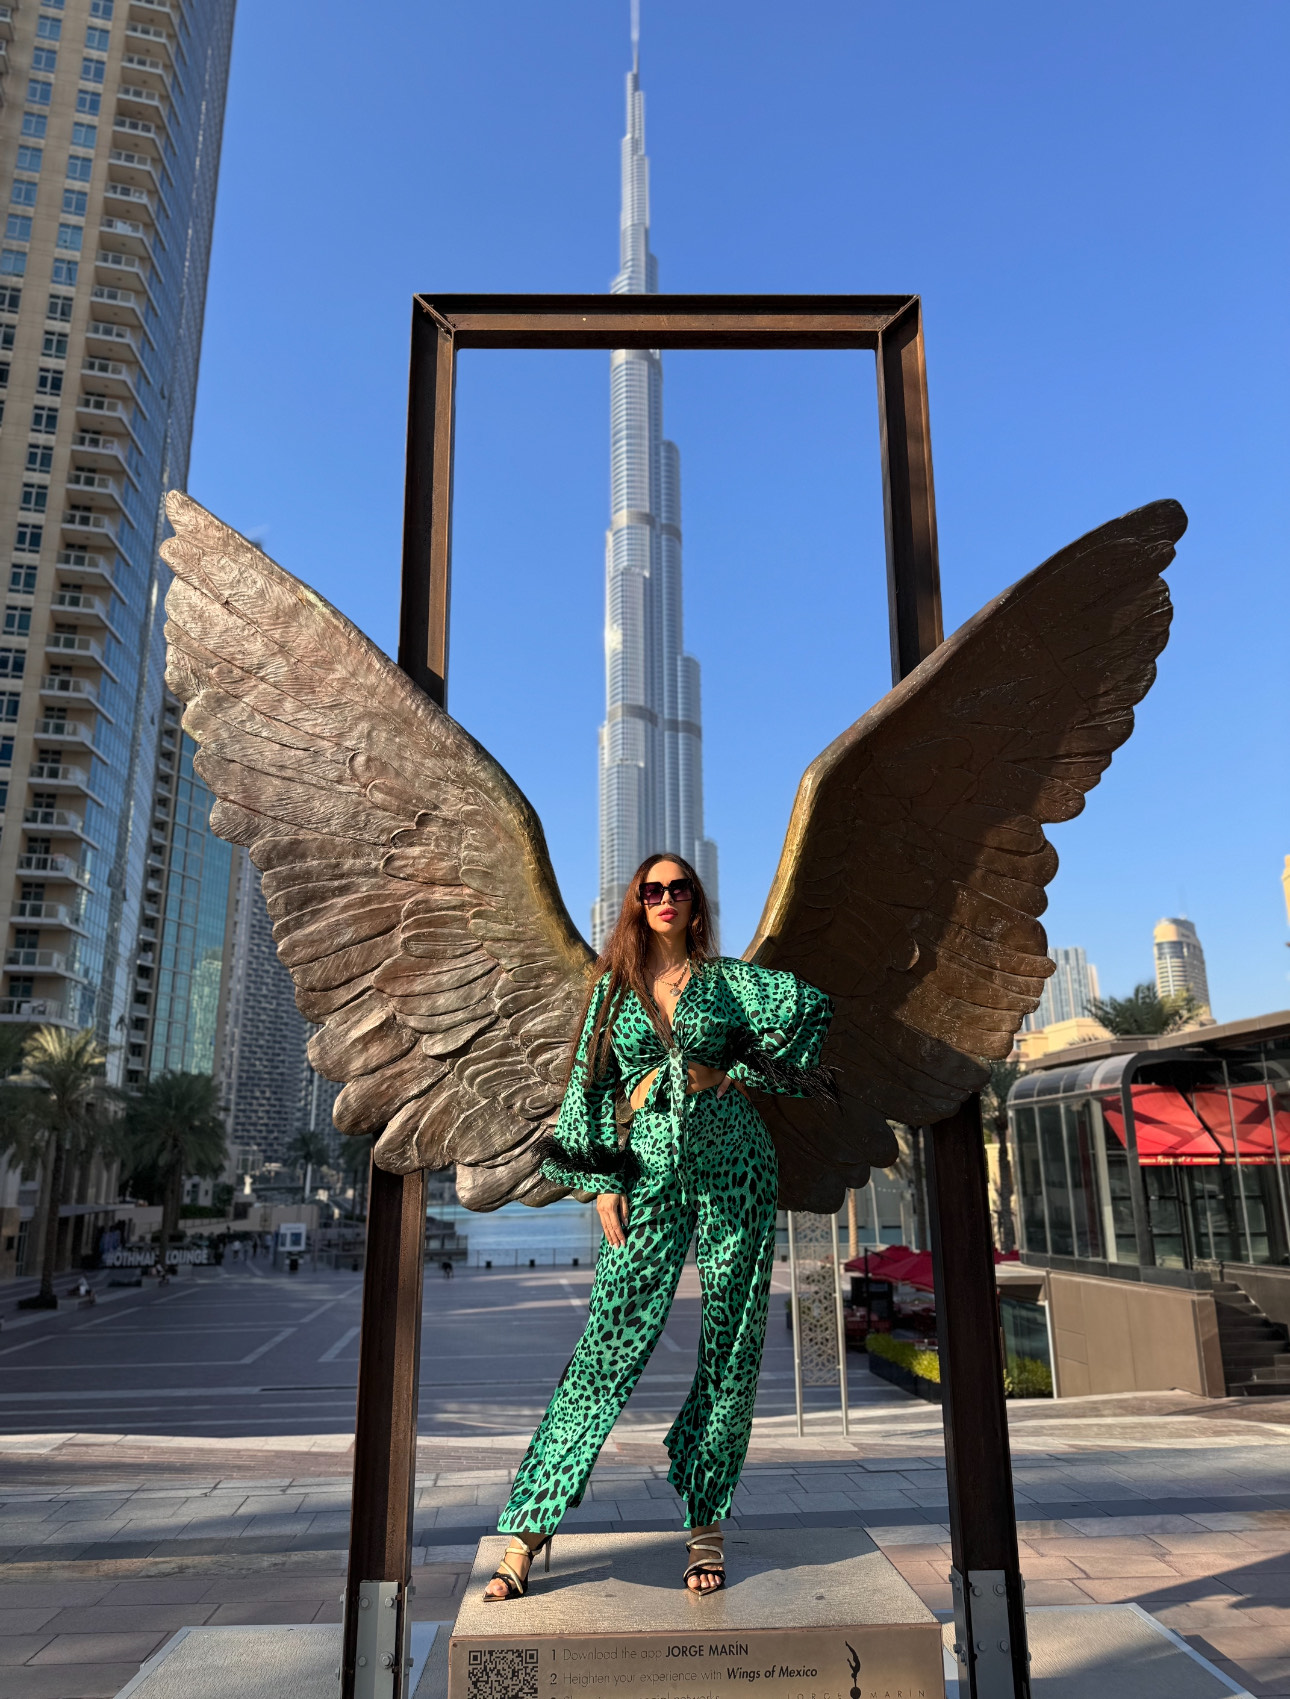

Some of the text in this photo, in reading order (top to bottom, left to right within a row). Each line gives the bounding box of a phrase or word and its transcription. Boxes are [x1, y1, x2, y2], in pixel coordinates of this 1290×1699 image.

[165, 1249, 208, 1264] LOUNGE
[551, 1641, 749, 1661] 1 Download the app JORGE MARÍN
[550, 1665, 818, 1688] 2 Heighten your experience with Wings of Mexico
